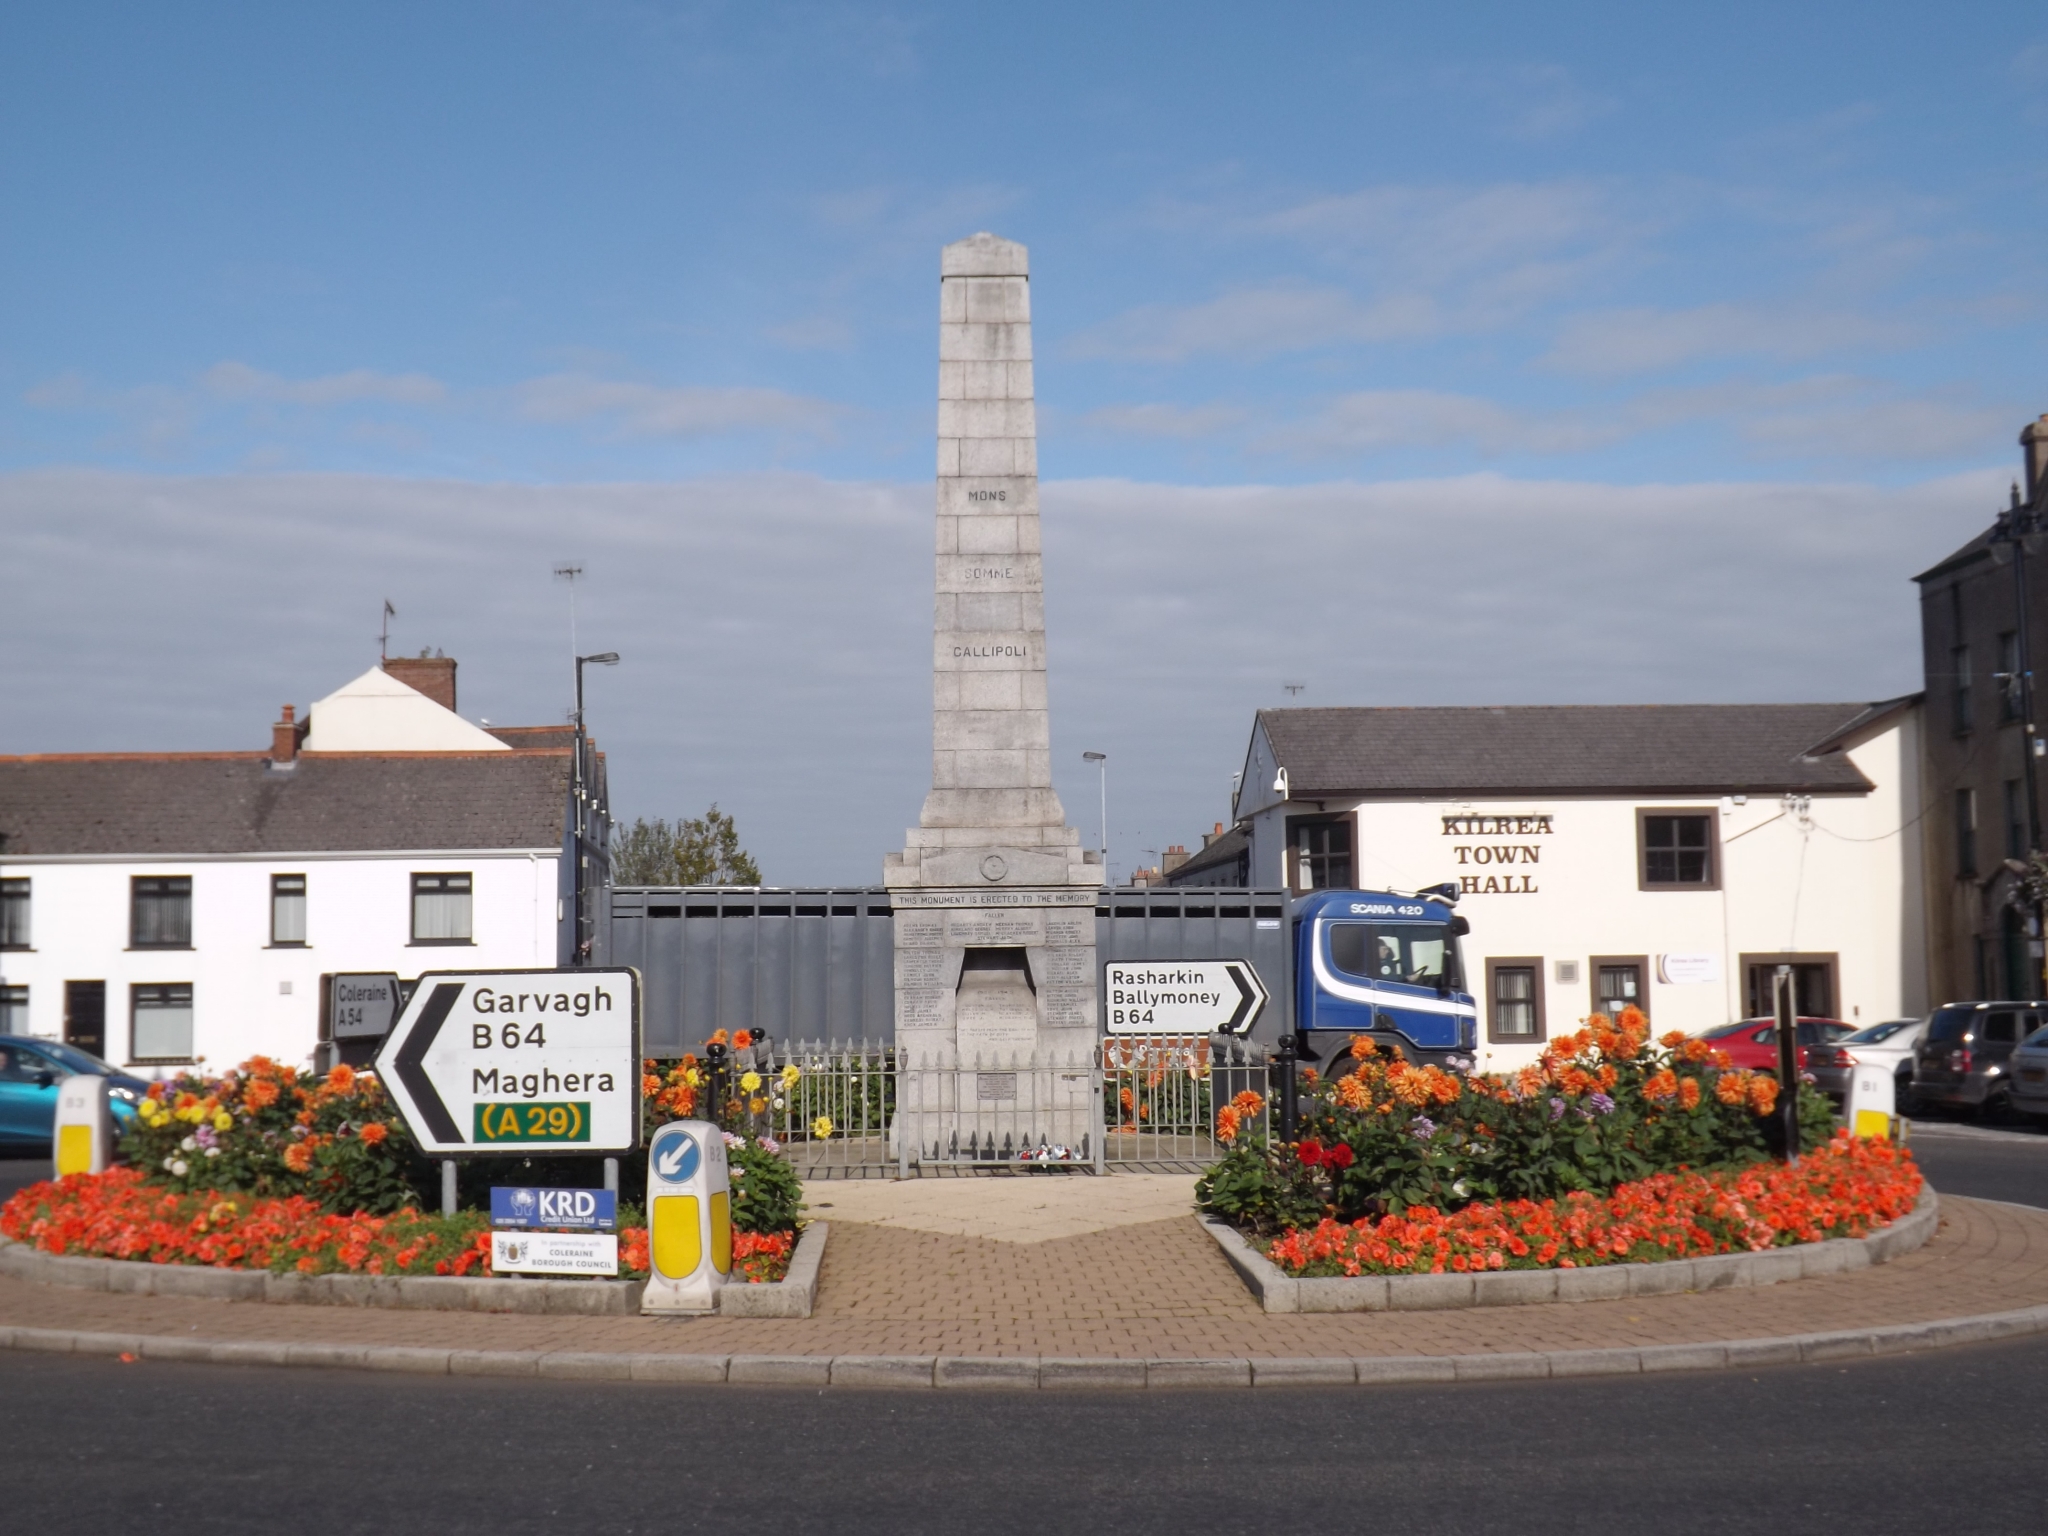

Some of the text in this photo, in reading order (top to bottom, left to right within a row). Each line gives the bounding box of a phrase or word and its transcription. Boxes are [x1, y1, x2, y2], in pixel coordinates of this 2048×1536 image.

[969, 491, 1006, 501] MONS
[964, 568, 1013, 579] SOMME
[1441, 816, 1554, 835] KILREA
[1454, 845, 1541, 864] TOWN
[1459, 875, 1538, 894] HALL
[900, 896, 916, 904] THIS
[921, 896, 965, 904] MONUMENT
[970, 896, 977, 904] IS
[1023, 895, 1032, 903] TO
[1037, 895, 1052, 903] THE
[1056, 895, 1090, 903] MEMORY
[1350, 904, 1423, 915] SCANIA 420
[1113, 970, 1204, 984] Rasharkin
[339, 983, 387, 1002] Coleraine
[1113, 990, 1220, 1007] Ballymoney
[473, 986, 612, 1017] Garvagh
[473, 1067, 614, 1098] Maghera
[539, 1190, 595, 1217] KRD
[540, 1215, 561, 1223] Credit
[584, 1216, 594, 1224] Ltd
[550, 1249, 594, 1257] COLERAINE
[532, 1258, 611, 1268] BOROUGH COUNCIL
